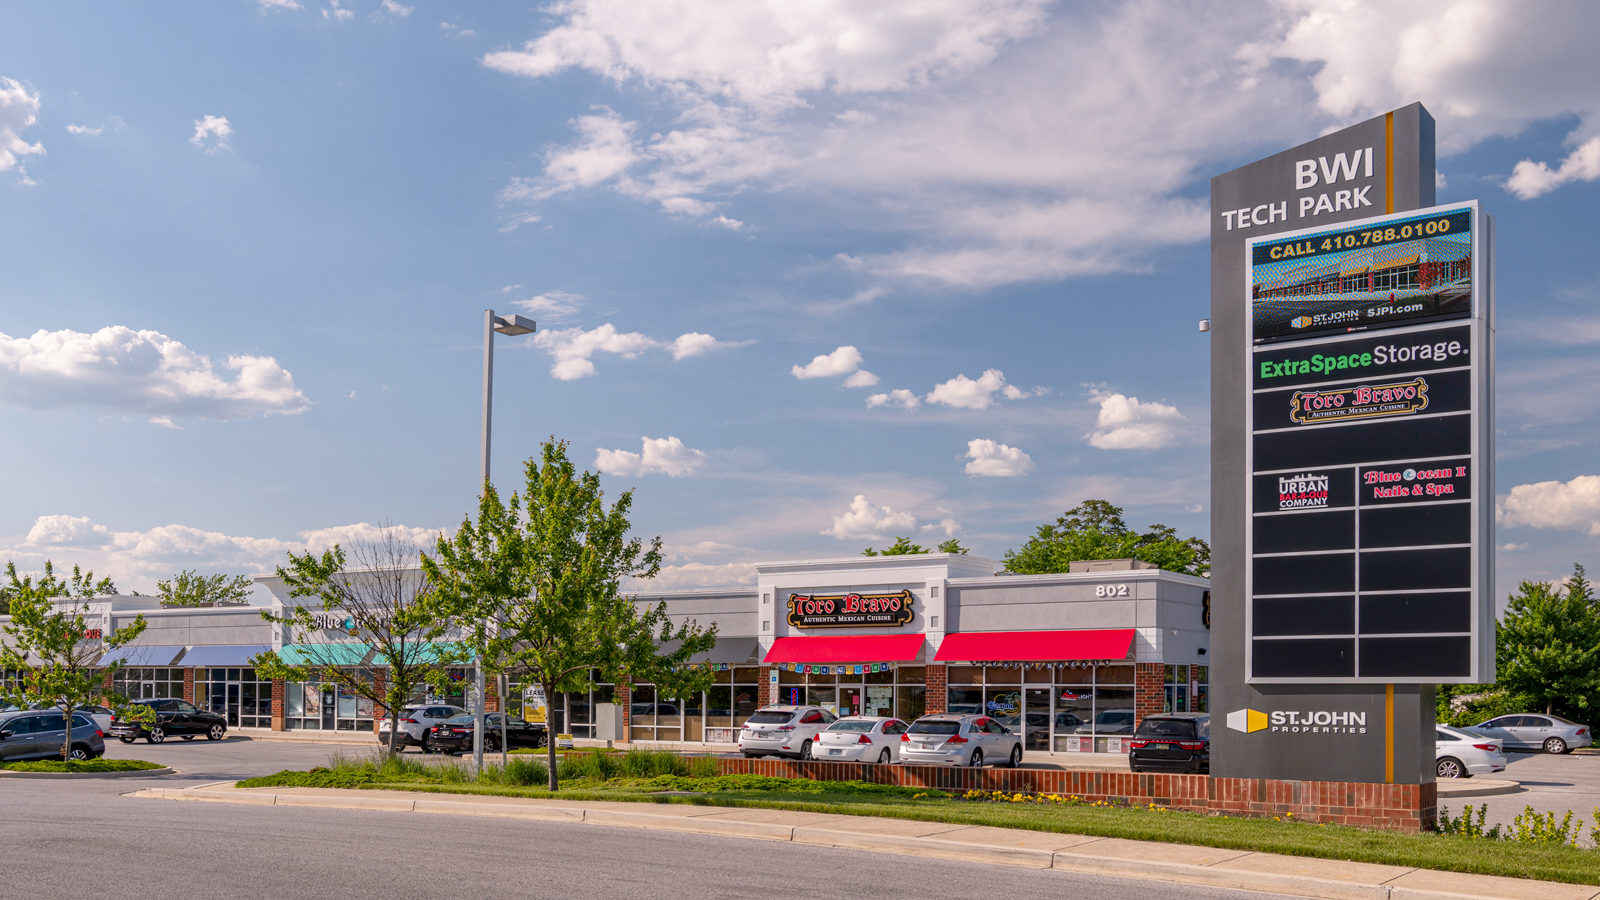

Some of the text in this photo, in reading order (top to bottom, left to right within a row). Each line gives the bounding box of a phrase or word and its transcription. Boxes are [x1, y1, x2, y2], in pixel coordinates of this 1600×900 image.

[1296, 147, 1374, 190] BWI
[1221, 185, 1373, 231] TECH PARK
[1270, 219, 1450, 259] CALL 410.788.0100
[1300, 386, 1416, 411] Toro Bravo
[1363, 471, 1401, 484] Blue
[1279, 480, 1329, 494] URBAN
[1374, 482, 1455, 498] Nails & Spa
[1279, 490, 1328, 501] BAR-B-QUE
[1280, 497, 1328, 508] COMPANY
[1095, 584, 1128, 597] 802
[794, 594, 901, 615] Toro Bravo
[1272, 726, 1367, 734] PROPERTIES
